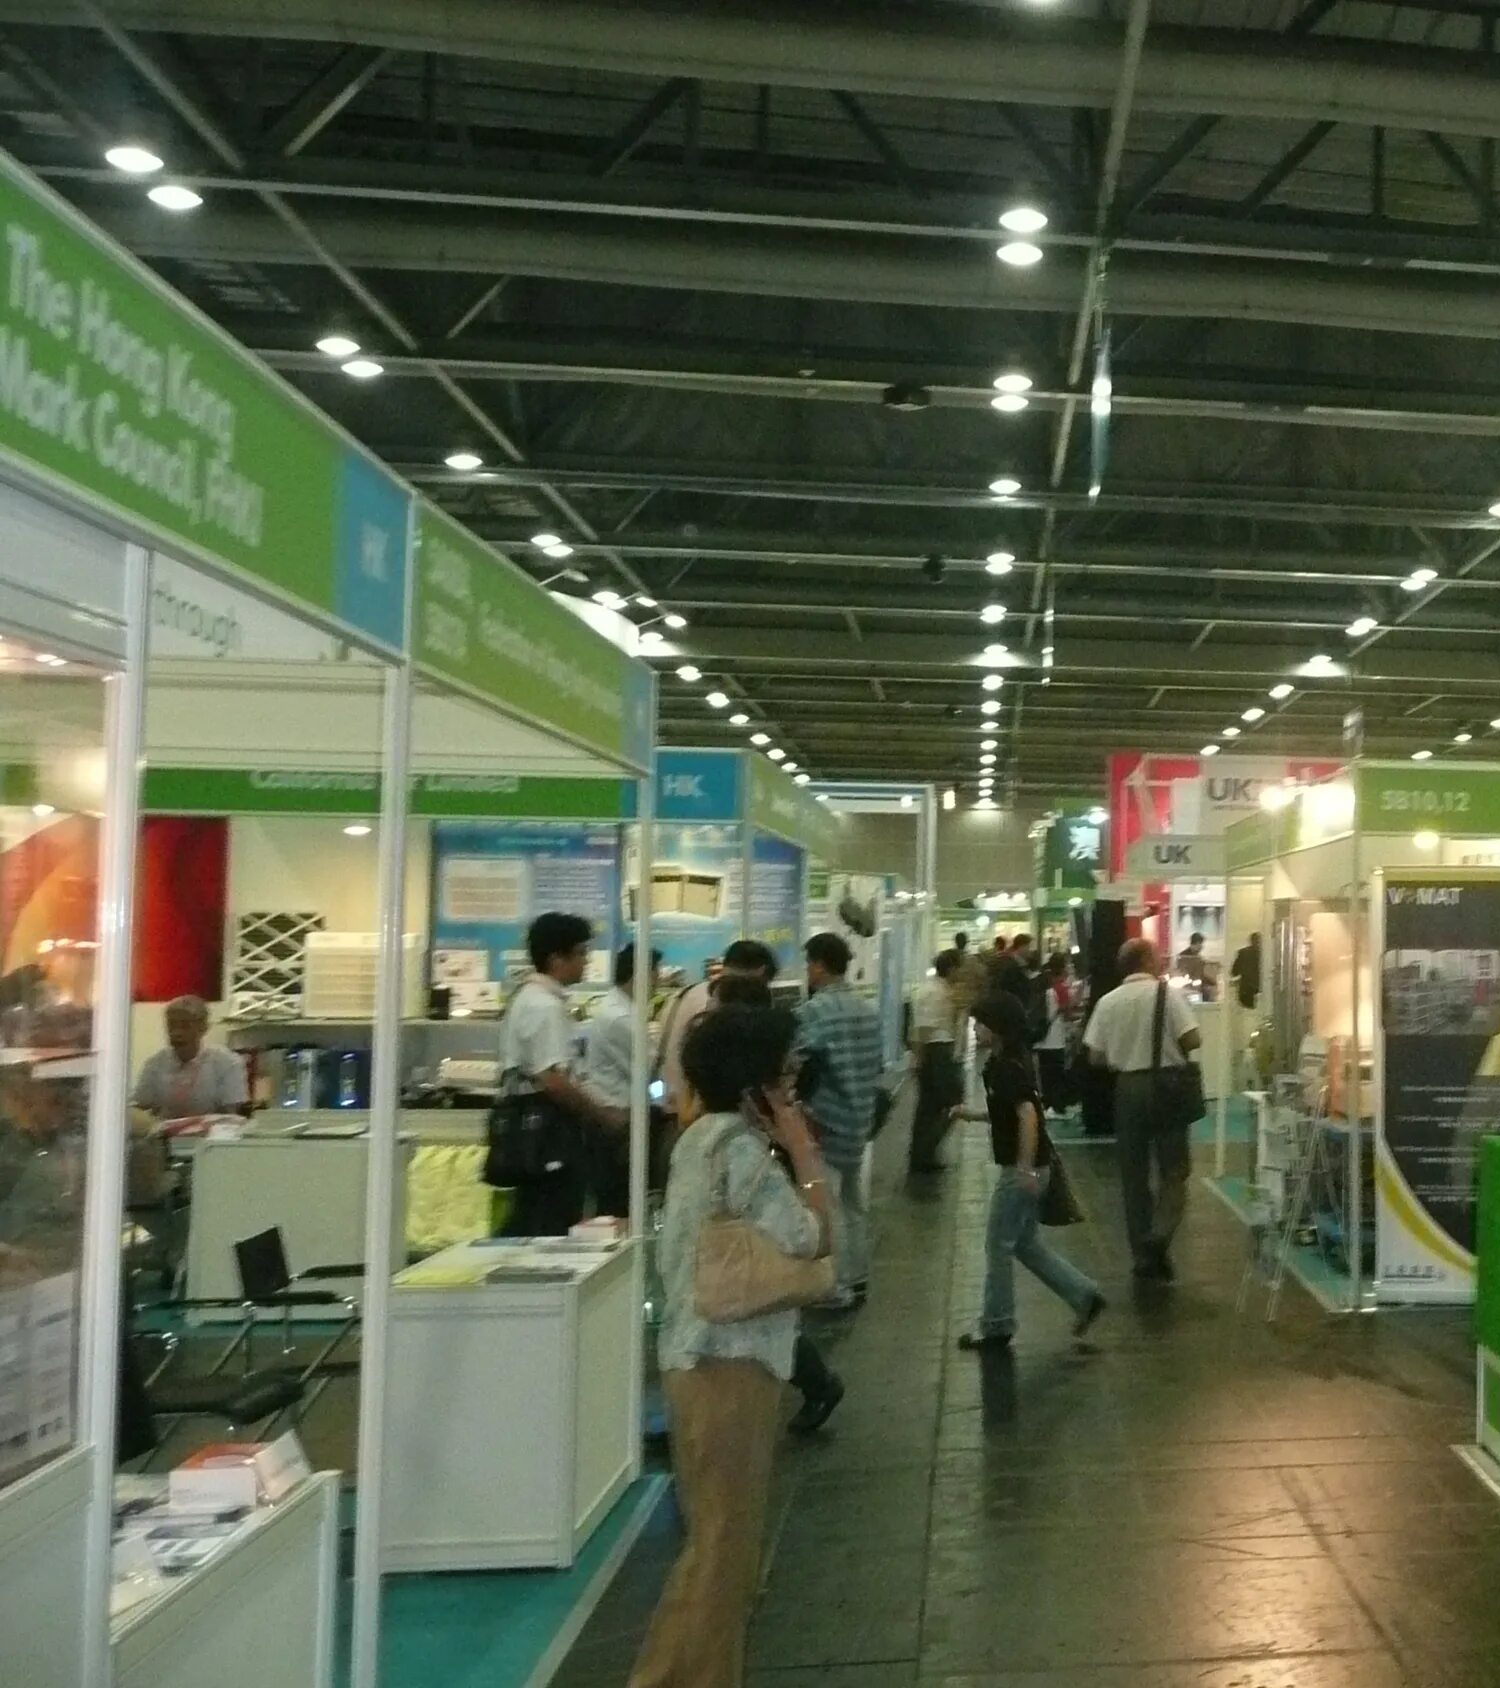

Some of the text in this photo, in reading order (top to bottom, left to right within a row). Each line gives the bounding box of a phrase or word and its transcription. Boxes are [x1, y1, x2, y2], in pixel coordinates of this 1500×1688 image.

[7, 224, 236, 463] The Hong Kong
[662, 774, 704, 797] HK
[1207, 778, 1252, 800] UK
[1154, 844, 1191, 865] UK
